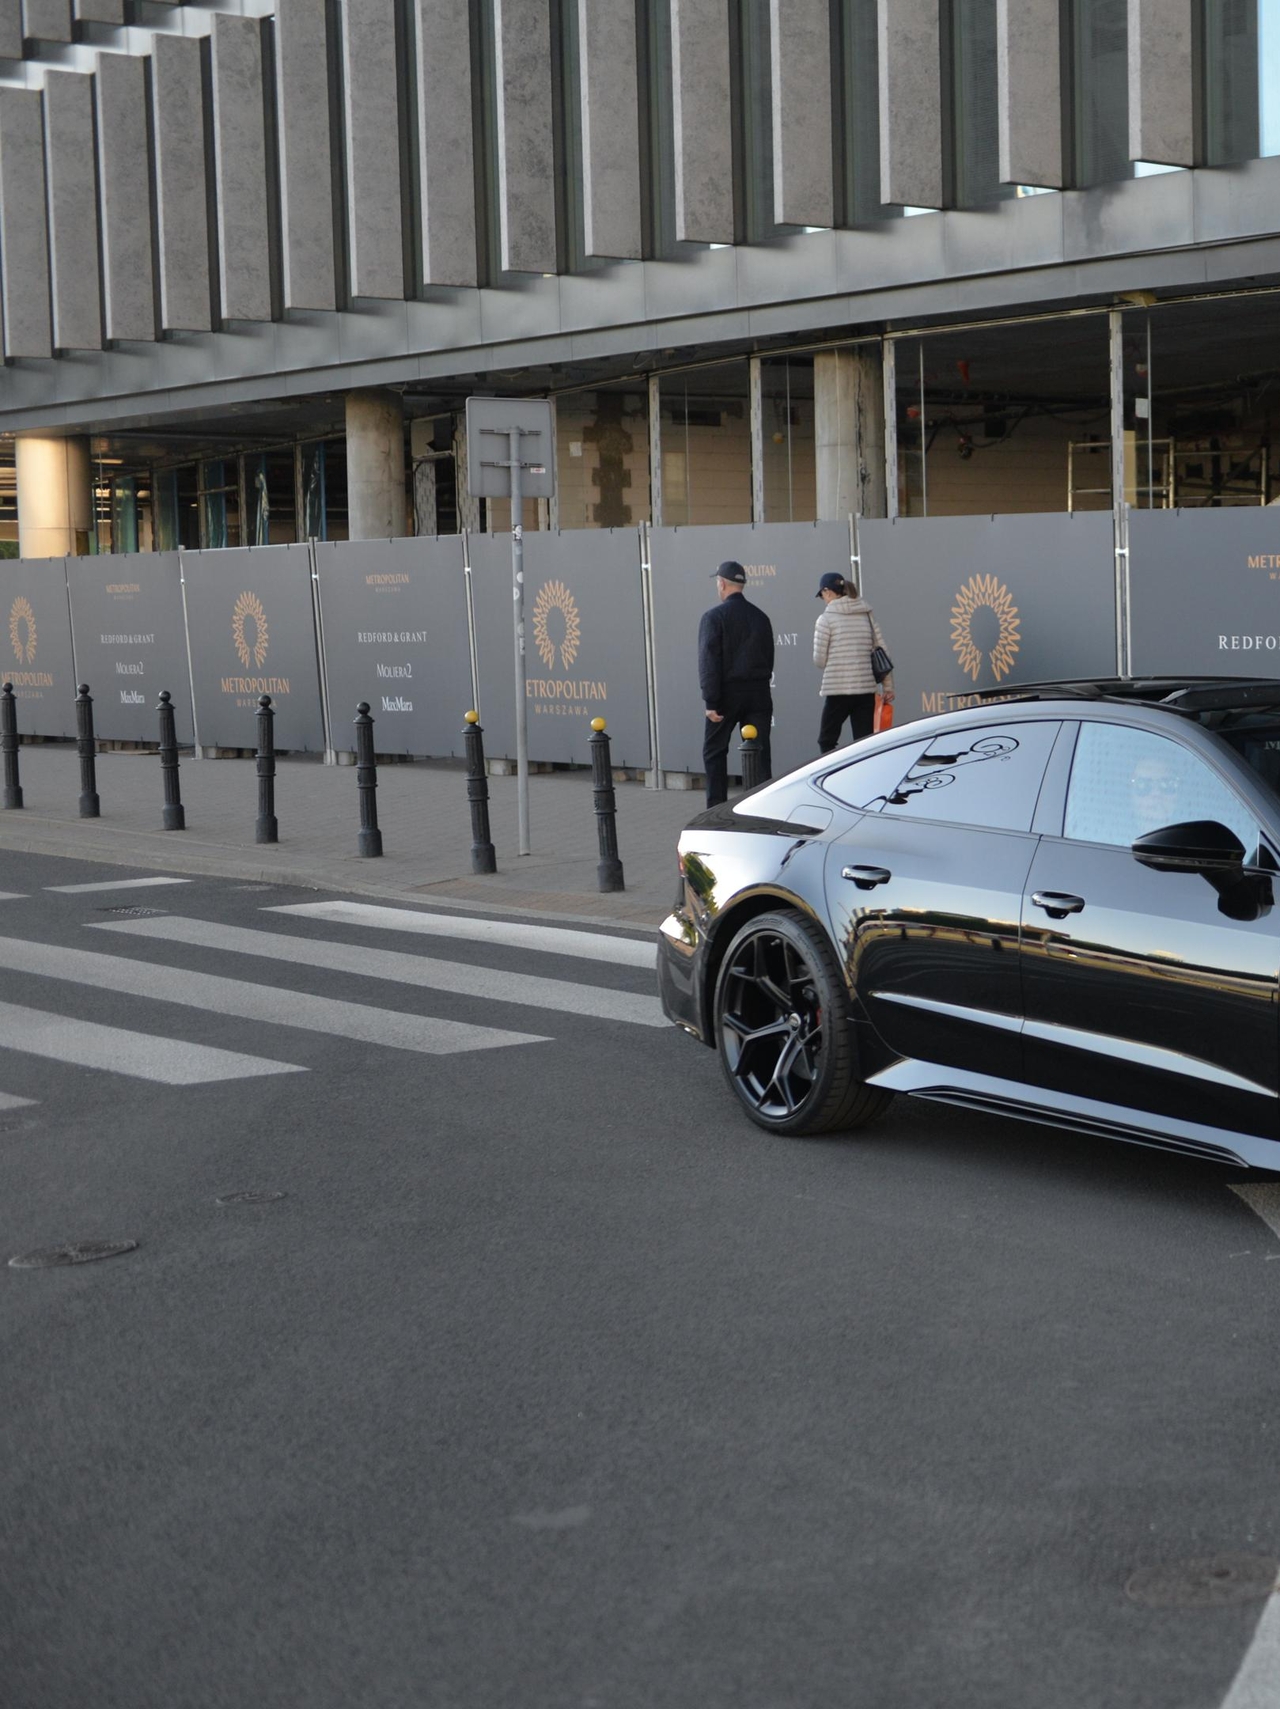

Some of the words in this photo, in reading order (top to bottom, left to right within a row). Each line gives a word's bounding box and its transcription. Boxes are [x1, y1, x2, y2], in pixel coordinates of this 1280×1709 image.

[365, 573, 410, 584] METROPOLITAN
[358, 632, 393, 642] REDFORD
[393, 632, 400, 642] &
[400, 631, 427, 642] GRANT
[775, 632, 798, 646] ANT
[376, 663, 412, 678] MOLIERA2
[221, 677, 290, 693] METROPOLITAN
[526, 679, 607, 701] ETROPOLITAN
[381, 696, 413, 712] MaxMara
[534, 703, 589, 716] WARSZAWA
